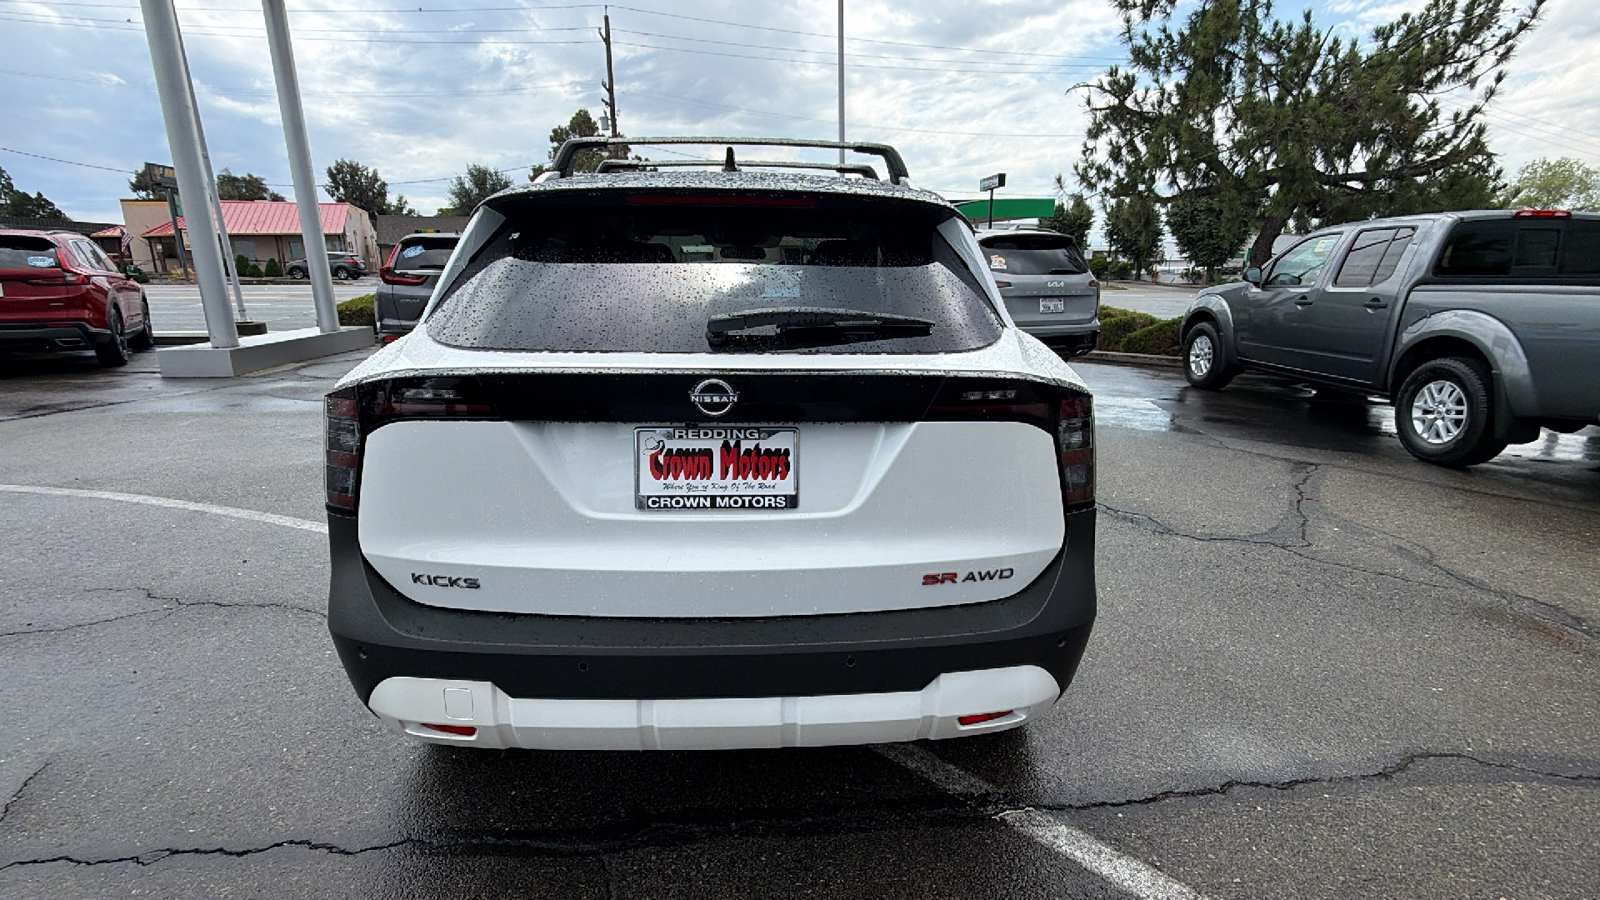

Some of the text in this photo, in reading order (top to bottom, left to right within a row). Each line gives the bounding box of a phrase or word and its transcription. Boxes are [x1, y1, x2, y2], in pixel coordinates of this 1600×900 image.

[691, 395, 738, 403] NISSAN
[674, 429, 759, 439] REDDING
[649, 440, 790, 480] Crown Motors
[662, 481, 777, 493] Where You're King Of The Road
[647, 496, 786, 508] CROWN MOTORS
[411, 572, 480, 589] KICKS
[921, 567, 1014, 585] SR AWD
